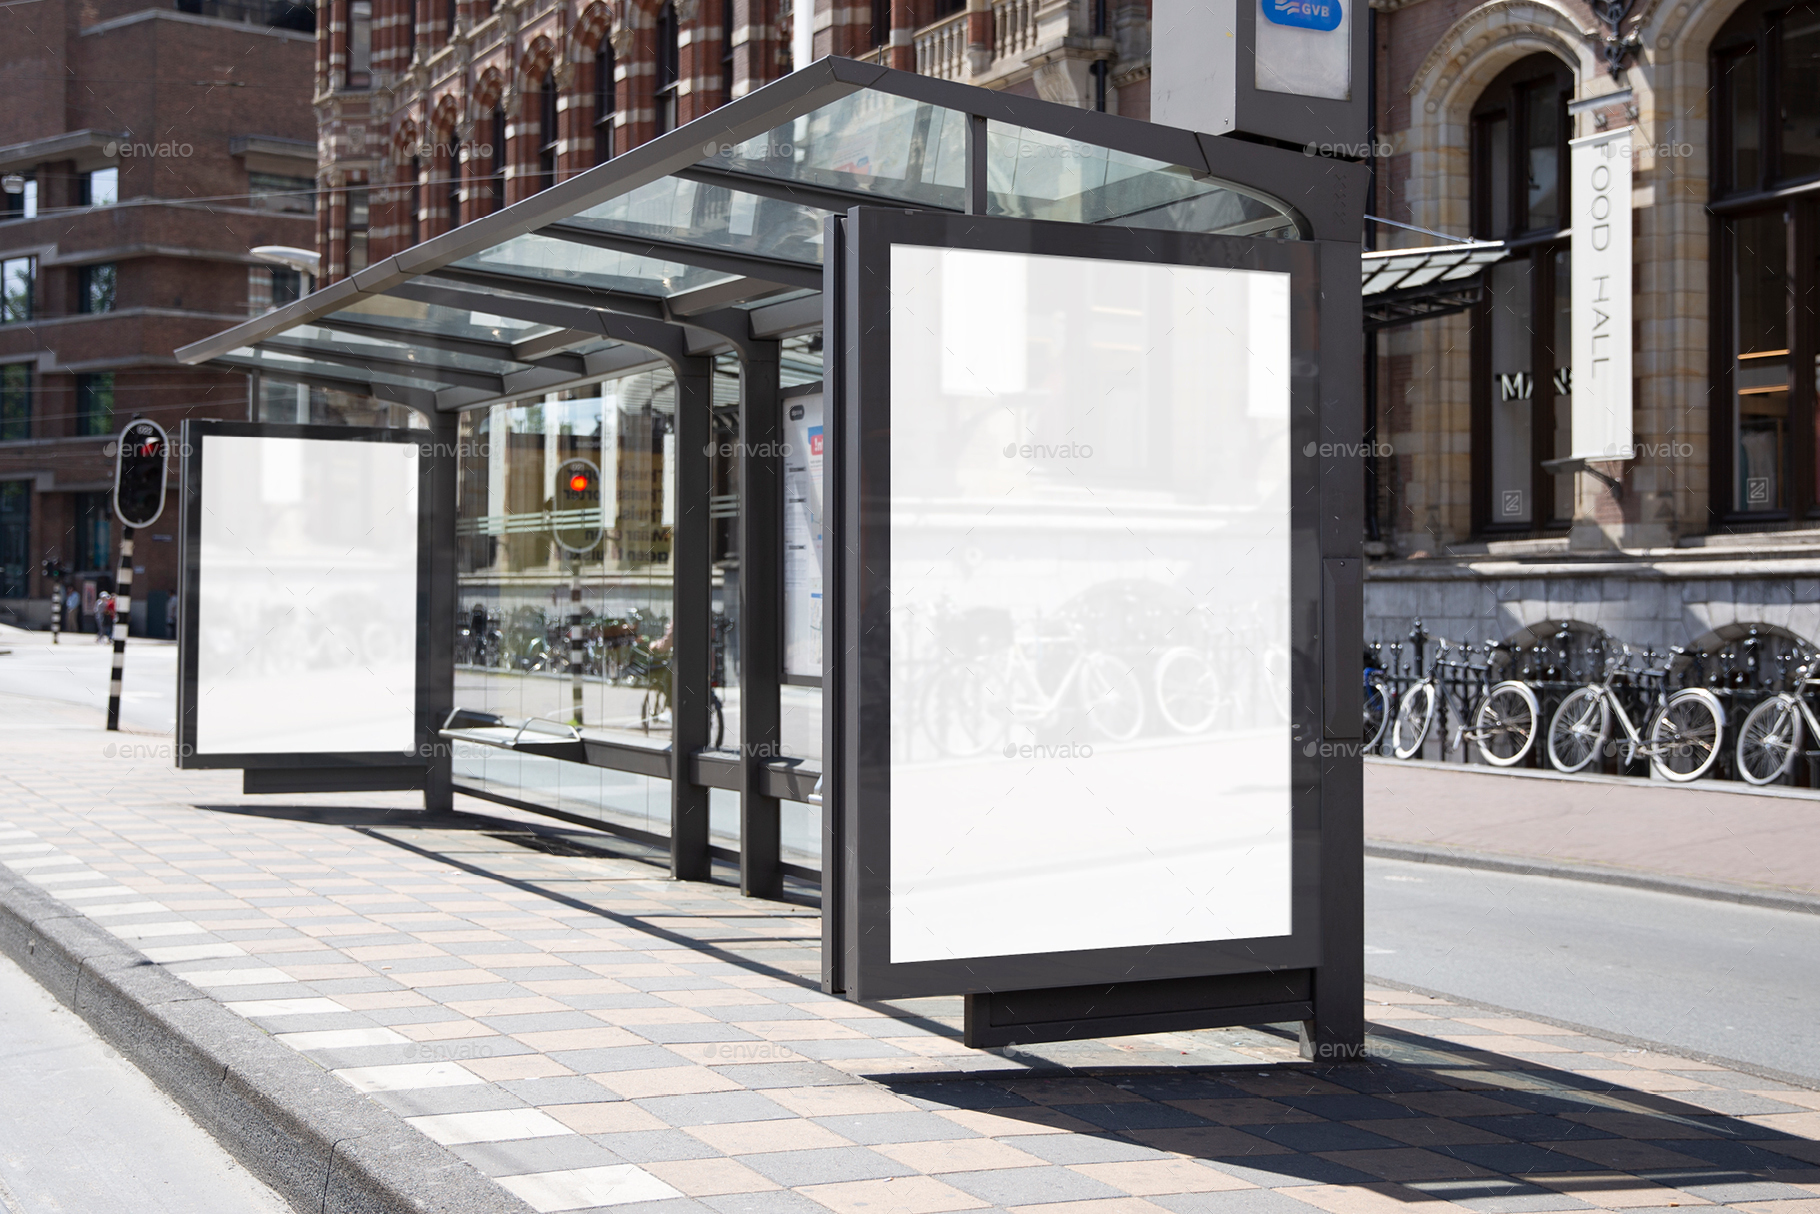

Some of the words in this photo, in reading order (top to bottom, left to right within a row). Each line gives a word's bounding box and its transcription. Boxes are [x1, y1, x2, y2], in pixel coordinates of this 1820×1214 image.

[1301, 3, 1330, 18] GVB
[1591, 142, 1610, 252] FOOD
[1592, 274, 1610, 380] HALL
